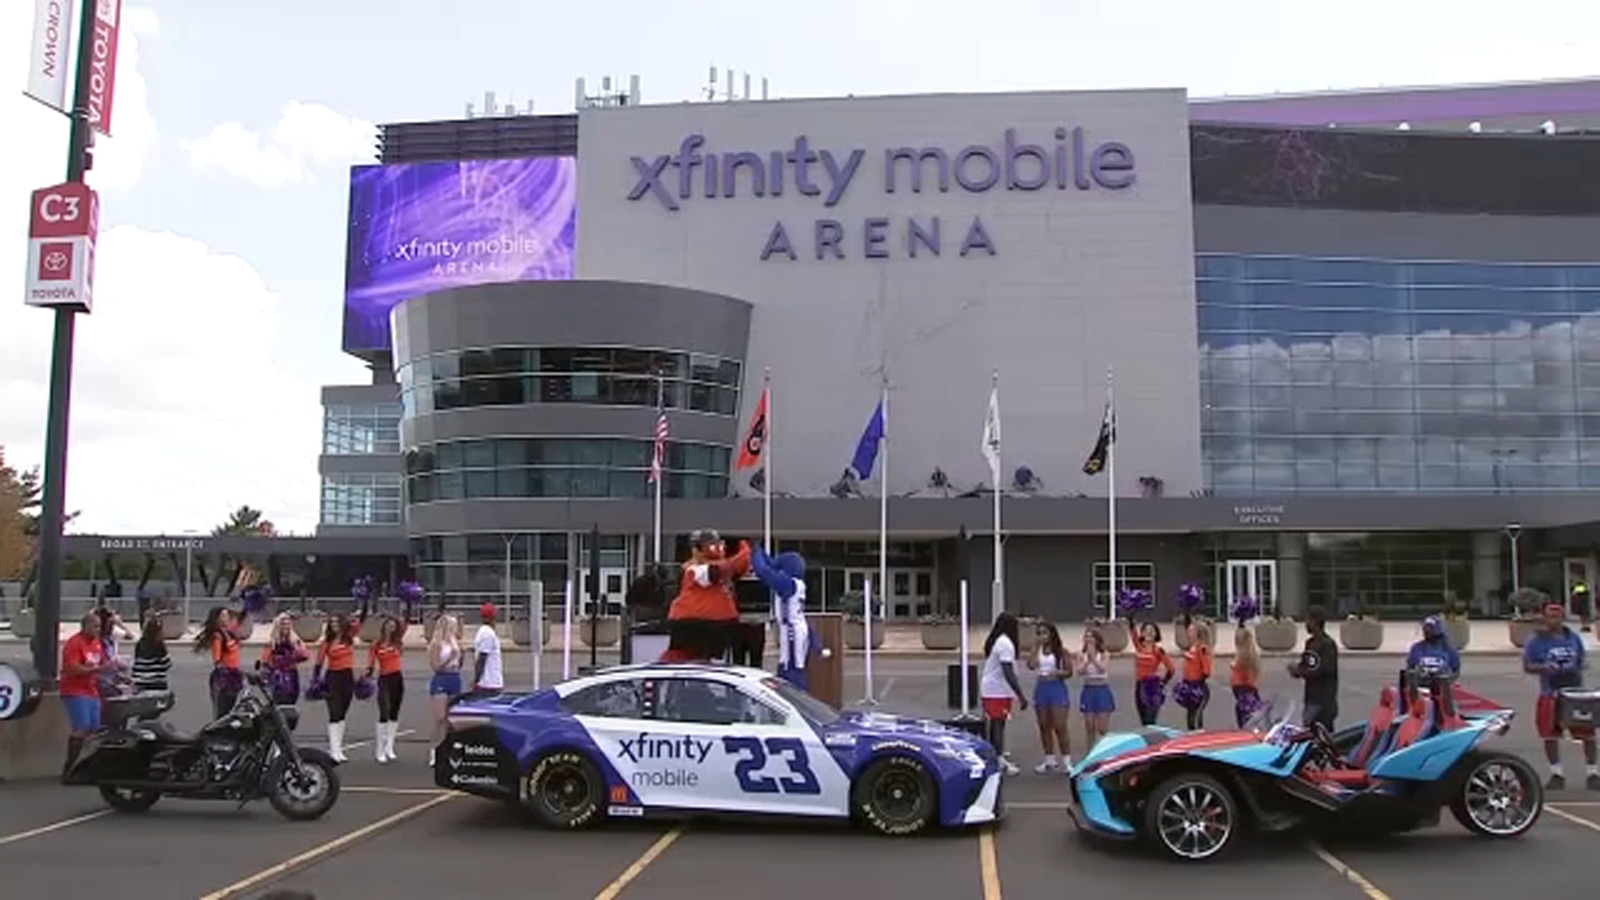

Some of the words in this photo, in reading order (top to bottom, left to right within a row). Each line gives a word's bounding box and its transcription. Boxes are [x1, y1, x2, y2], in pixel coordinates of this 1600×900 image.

[42, 1, 60, 79] CROWN
[87, 27, 109, 123] TOYOTA
[627, 134, 866, 211] xfinity
[884, 127, 1137, 193] mobile
[40, 193, 80, 222] C3
[394, 236, 463, 261] xfinity
[466, 234, 535, 255] mobile
[760, 216, 997, 260] ARENA
[431, 262, 500, 276] ARENA
[31, 288, 76, 299] TOYOTA
[618, 732, 714, 764] xfinity
[632, 769, 699, 787] mobile
[721, 735, 822, 796] 23
